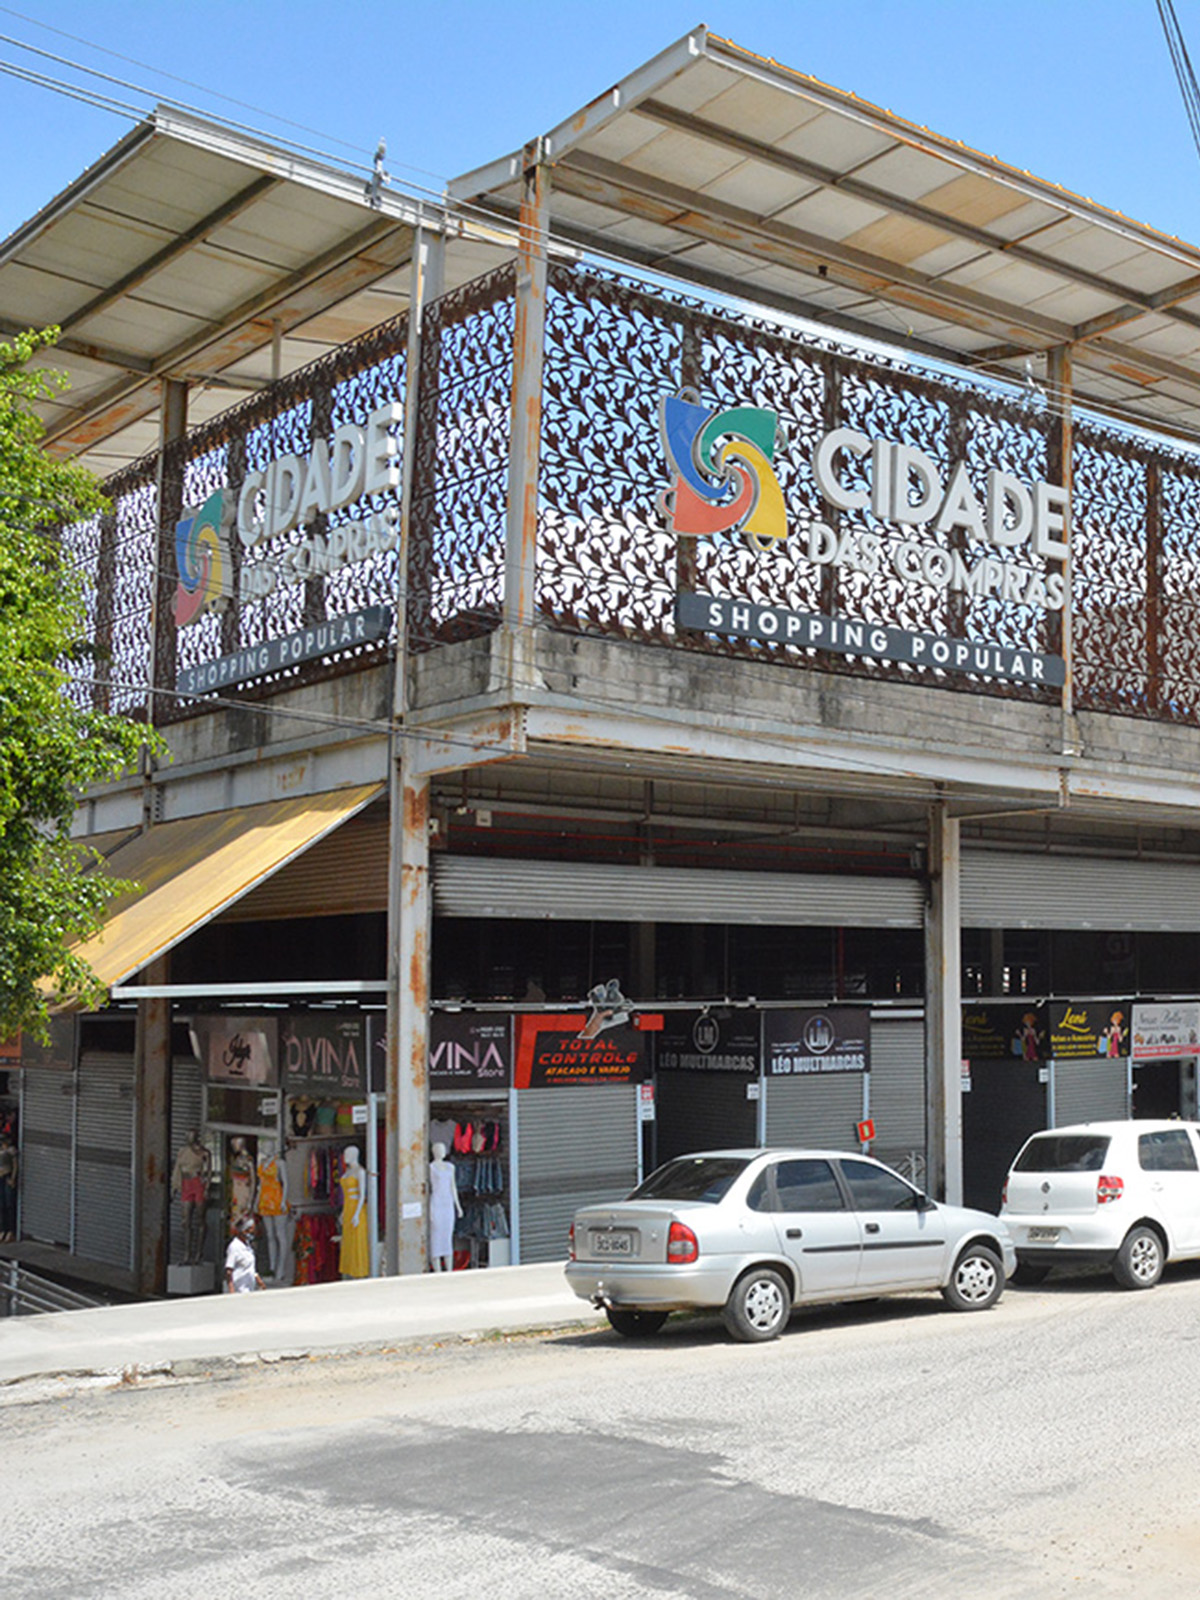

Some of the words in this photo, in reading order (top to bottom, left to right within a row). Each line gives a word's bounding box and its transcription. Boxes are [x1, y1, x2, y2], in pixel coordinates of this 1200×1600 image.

[238, 402, 402, 547] CIDADE
[813, 428, 1068, 560] CIDADE
[239, 565, 278, 600] DAS
[283, 507, 398, 581] COMPRAS
[808, 522, 880, 573] DAS
[895, 542, 1066, 610] COMPRAS
[188, 649, 269, 691] SHOPPING
[280, 616, 365, 663] POPULAR
[709, 603, 888, 651] SHOPPING
[912, 637, 1045, 679] POPULAR
[287, 1035, 360, 1075] DIVINA
[538, 1052, 638, 1065] CONTROLE
[560, 1039, 618, 1051] TOTAL
[771, 1054, 791, 1074] LÉO
